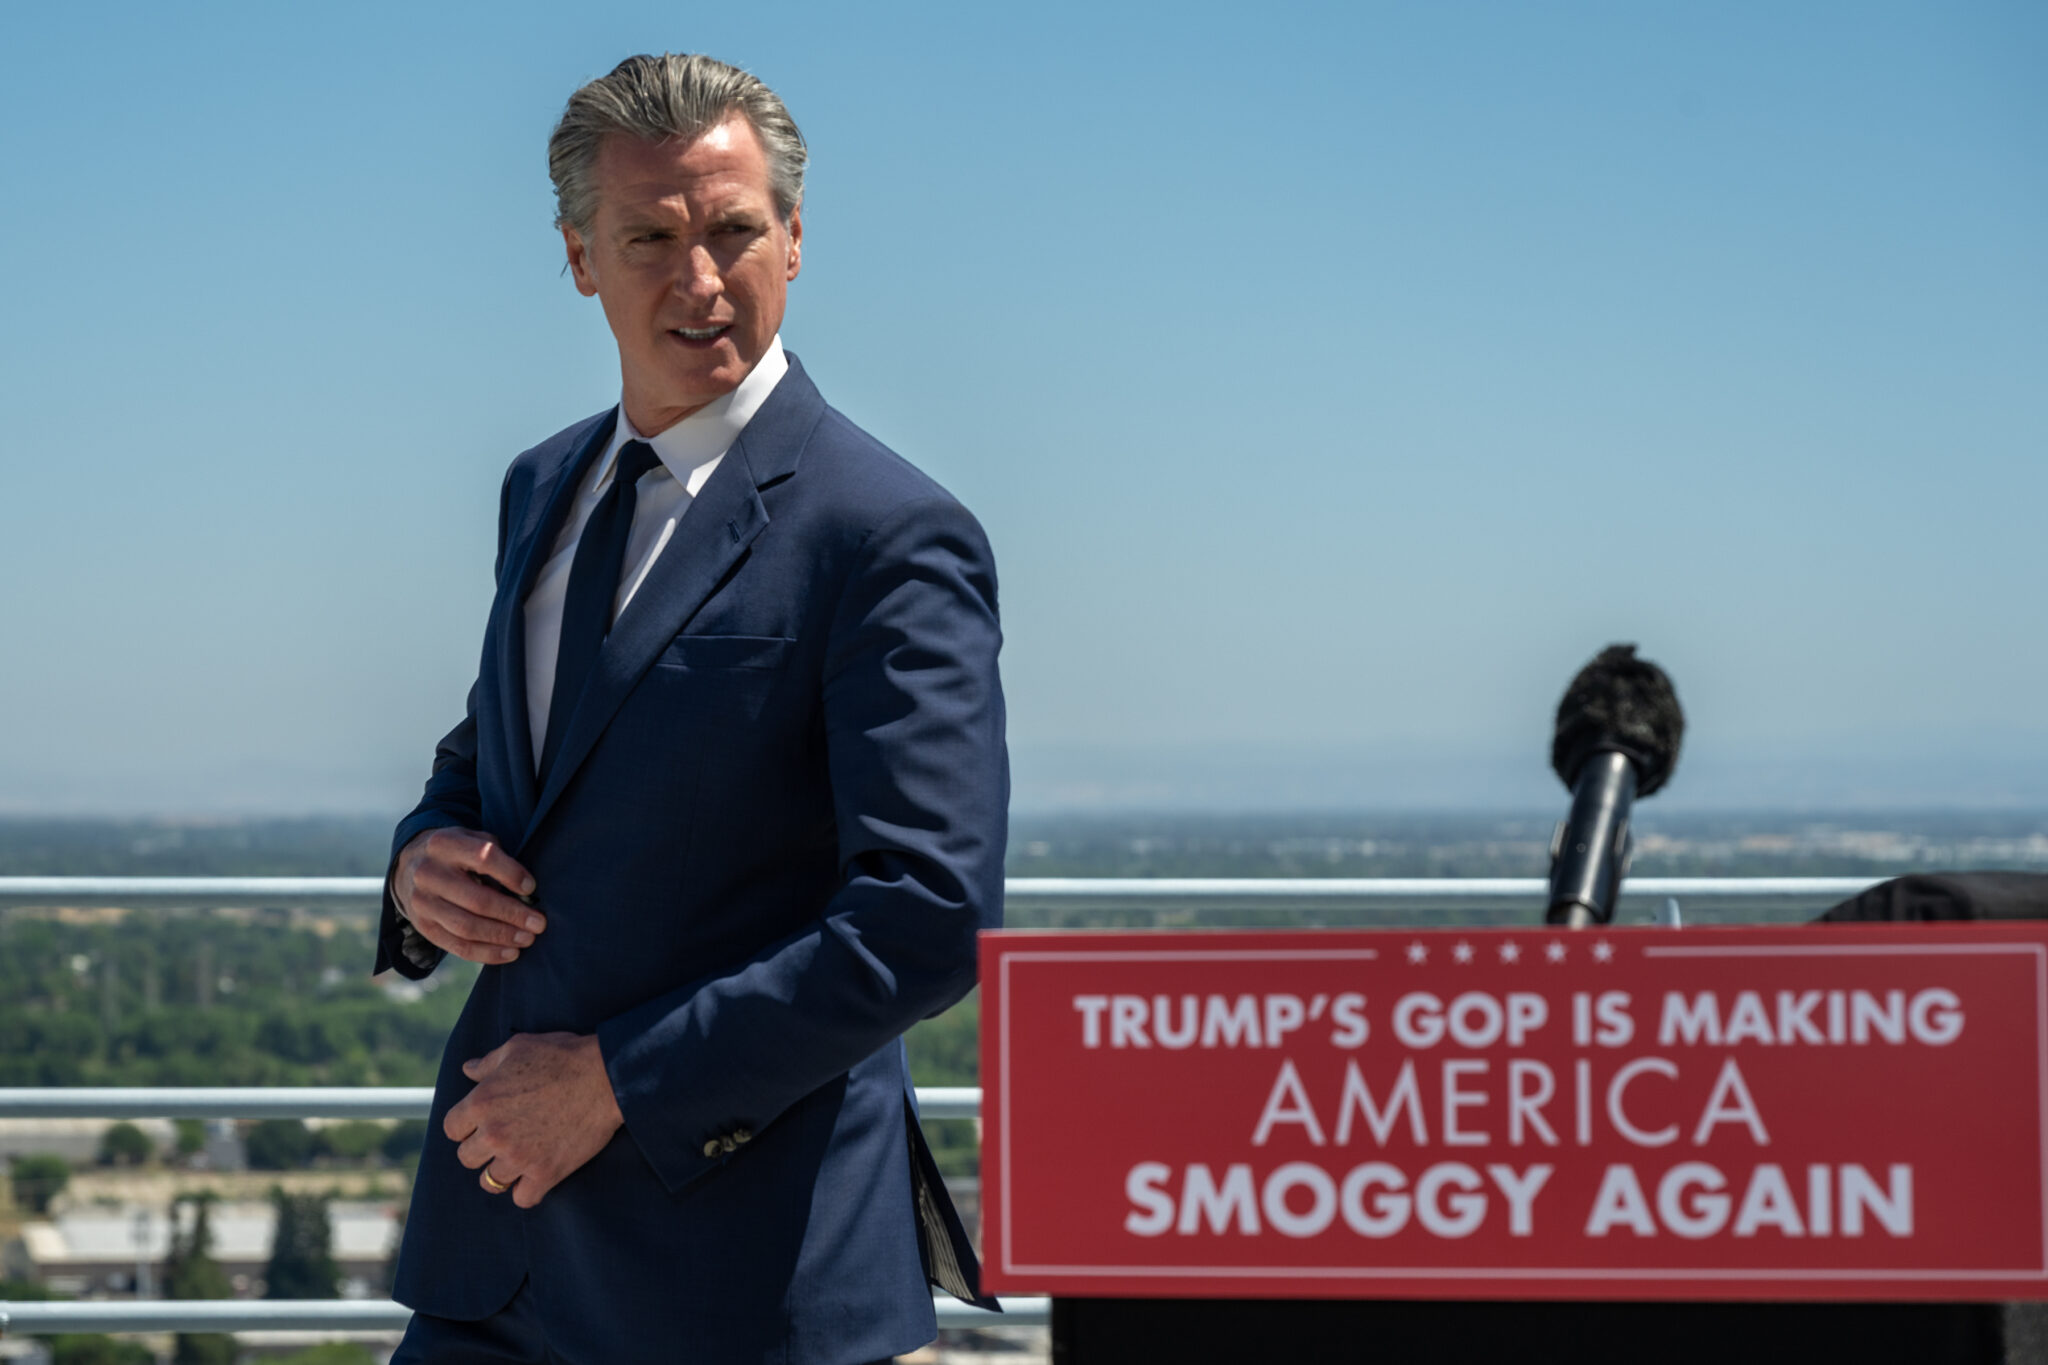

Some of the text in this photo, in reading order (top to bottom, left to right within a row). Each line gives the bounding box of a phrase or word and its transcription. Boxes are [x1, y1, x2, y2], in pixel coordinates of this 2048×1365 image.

[1074, 989, 1964, 1048] TRUMP'S GOP IS MAKING
[1252, 1058, 1770, 1146] AMERICA
[1125, 1163, 1914, 1237] SMOGGY AGAIN
